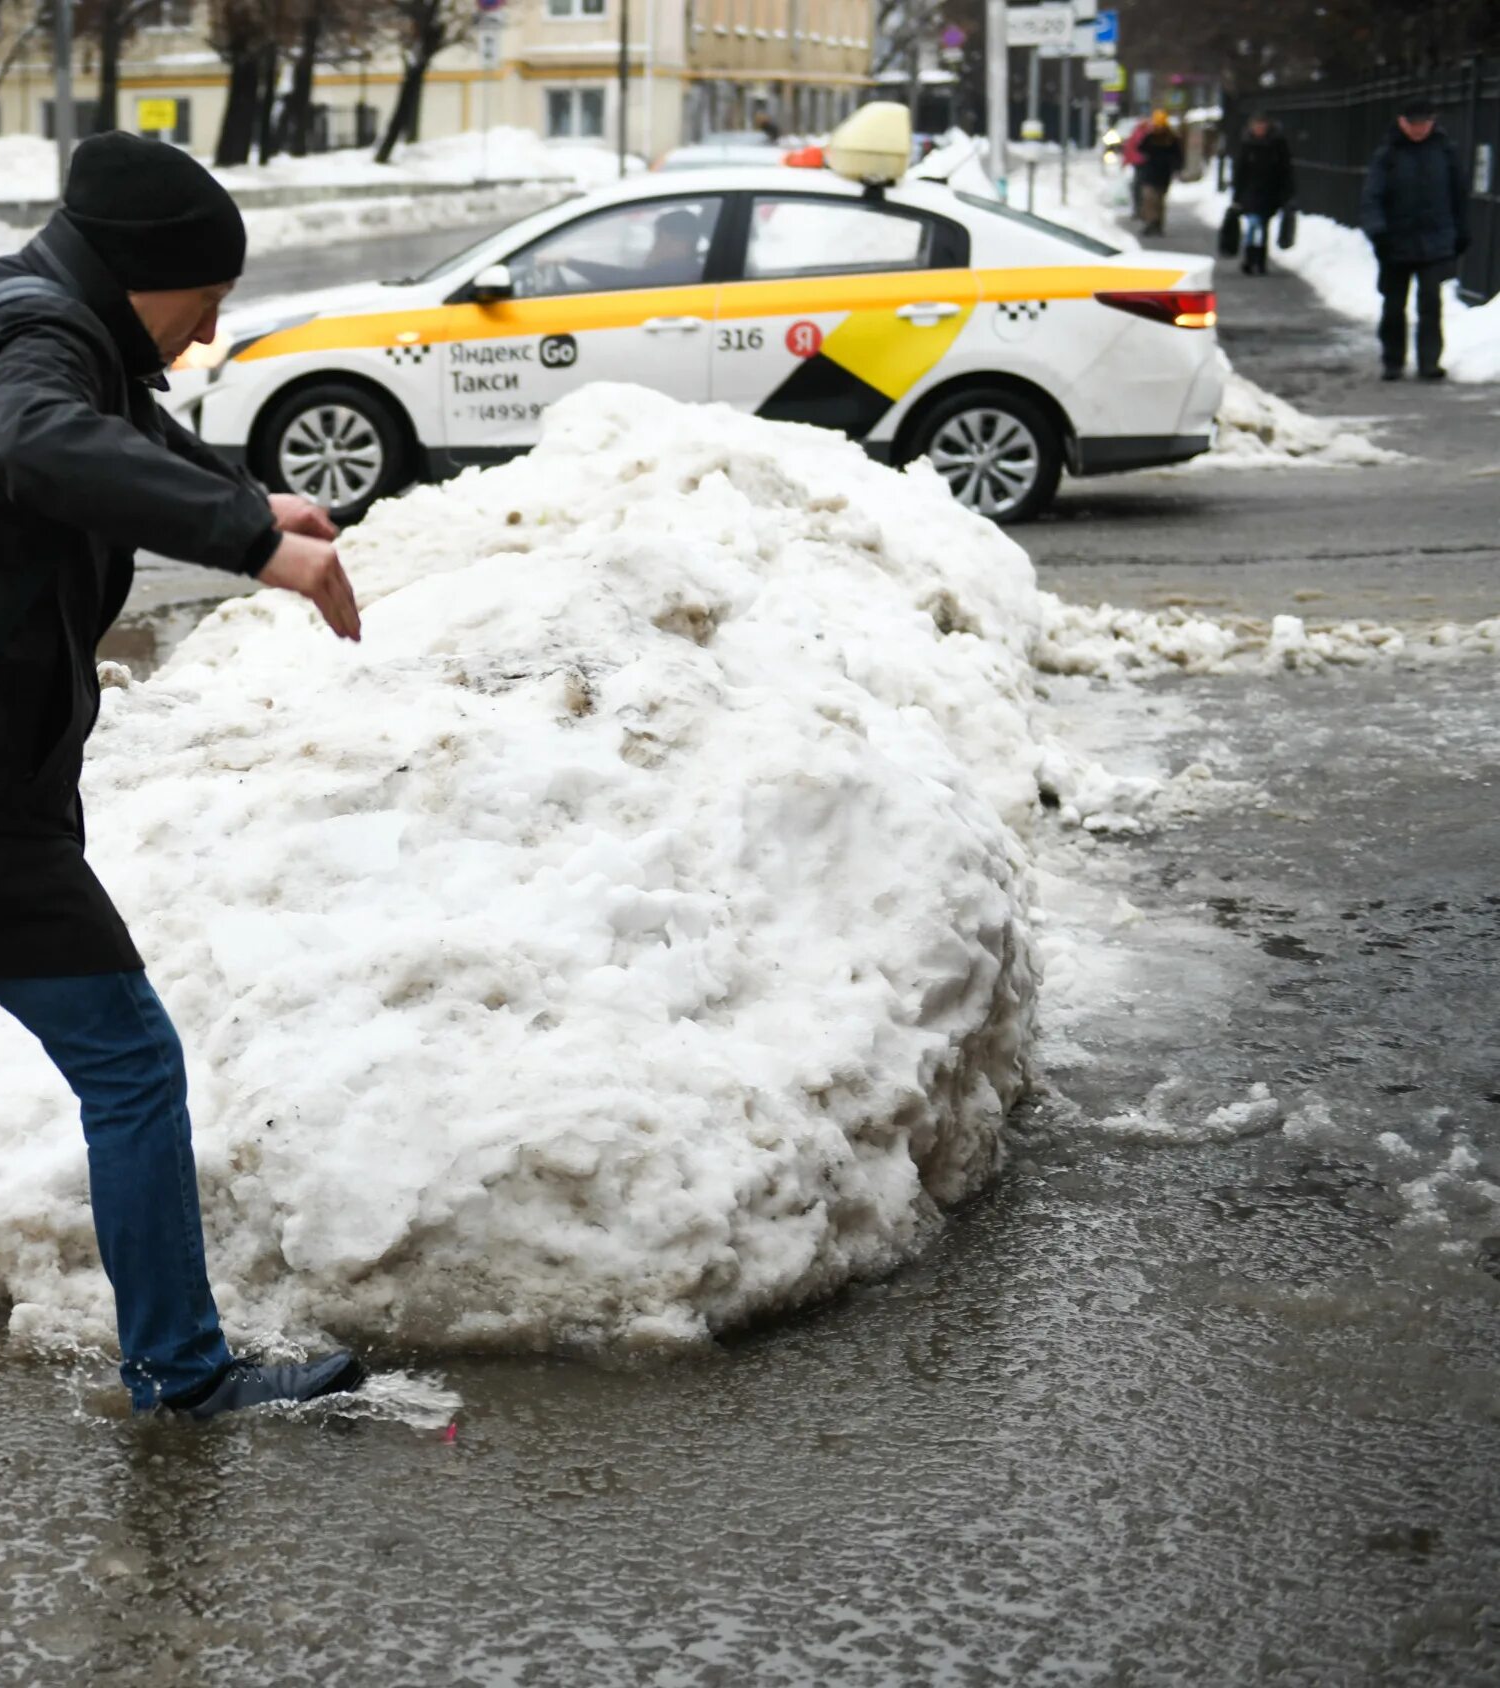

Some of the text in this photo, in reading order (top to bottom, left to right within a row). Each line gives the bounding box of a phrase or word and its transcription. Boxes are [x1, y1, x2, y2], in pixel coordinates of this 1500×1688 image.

[450, 338, 575, 365] Яндекс Go
[717, 327, 764, 352] 316
[795, 326, 813, 353] Я
[451, 370, 520, 394] Такси
